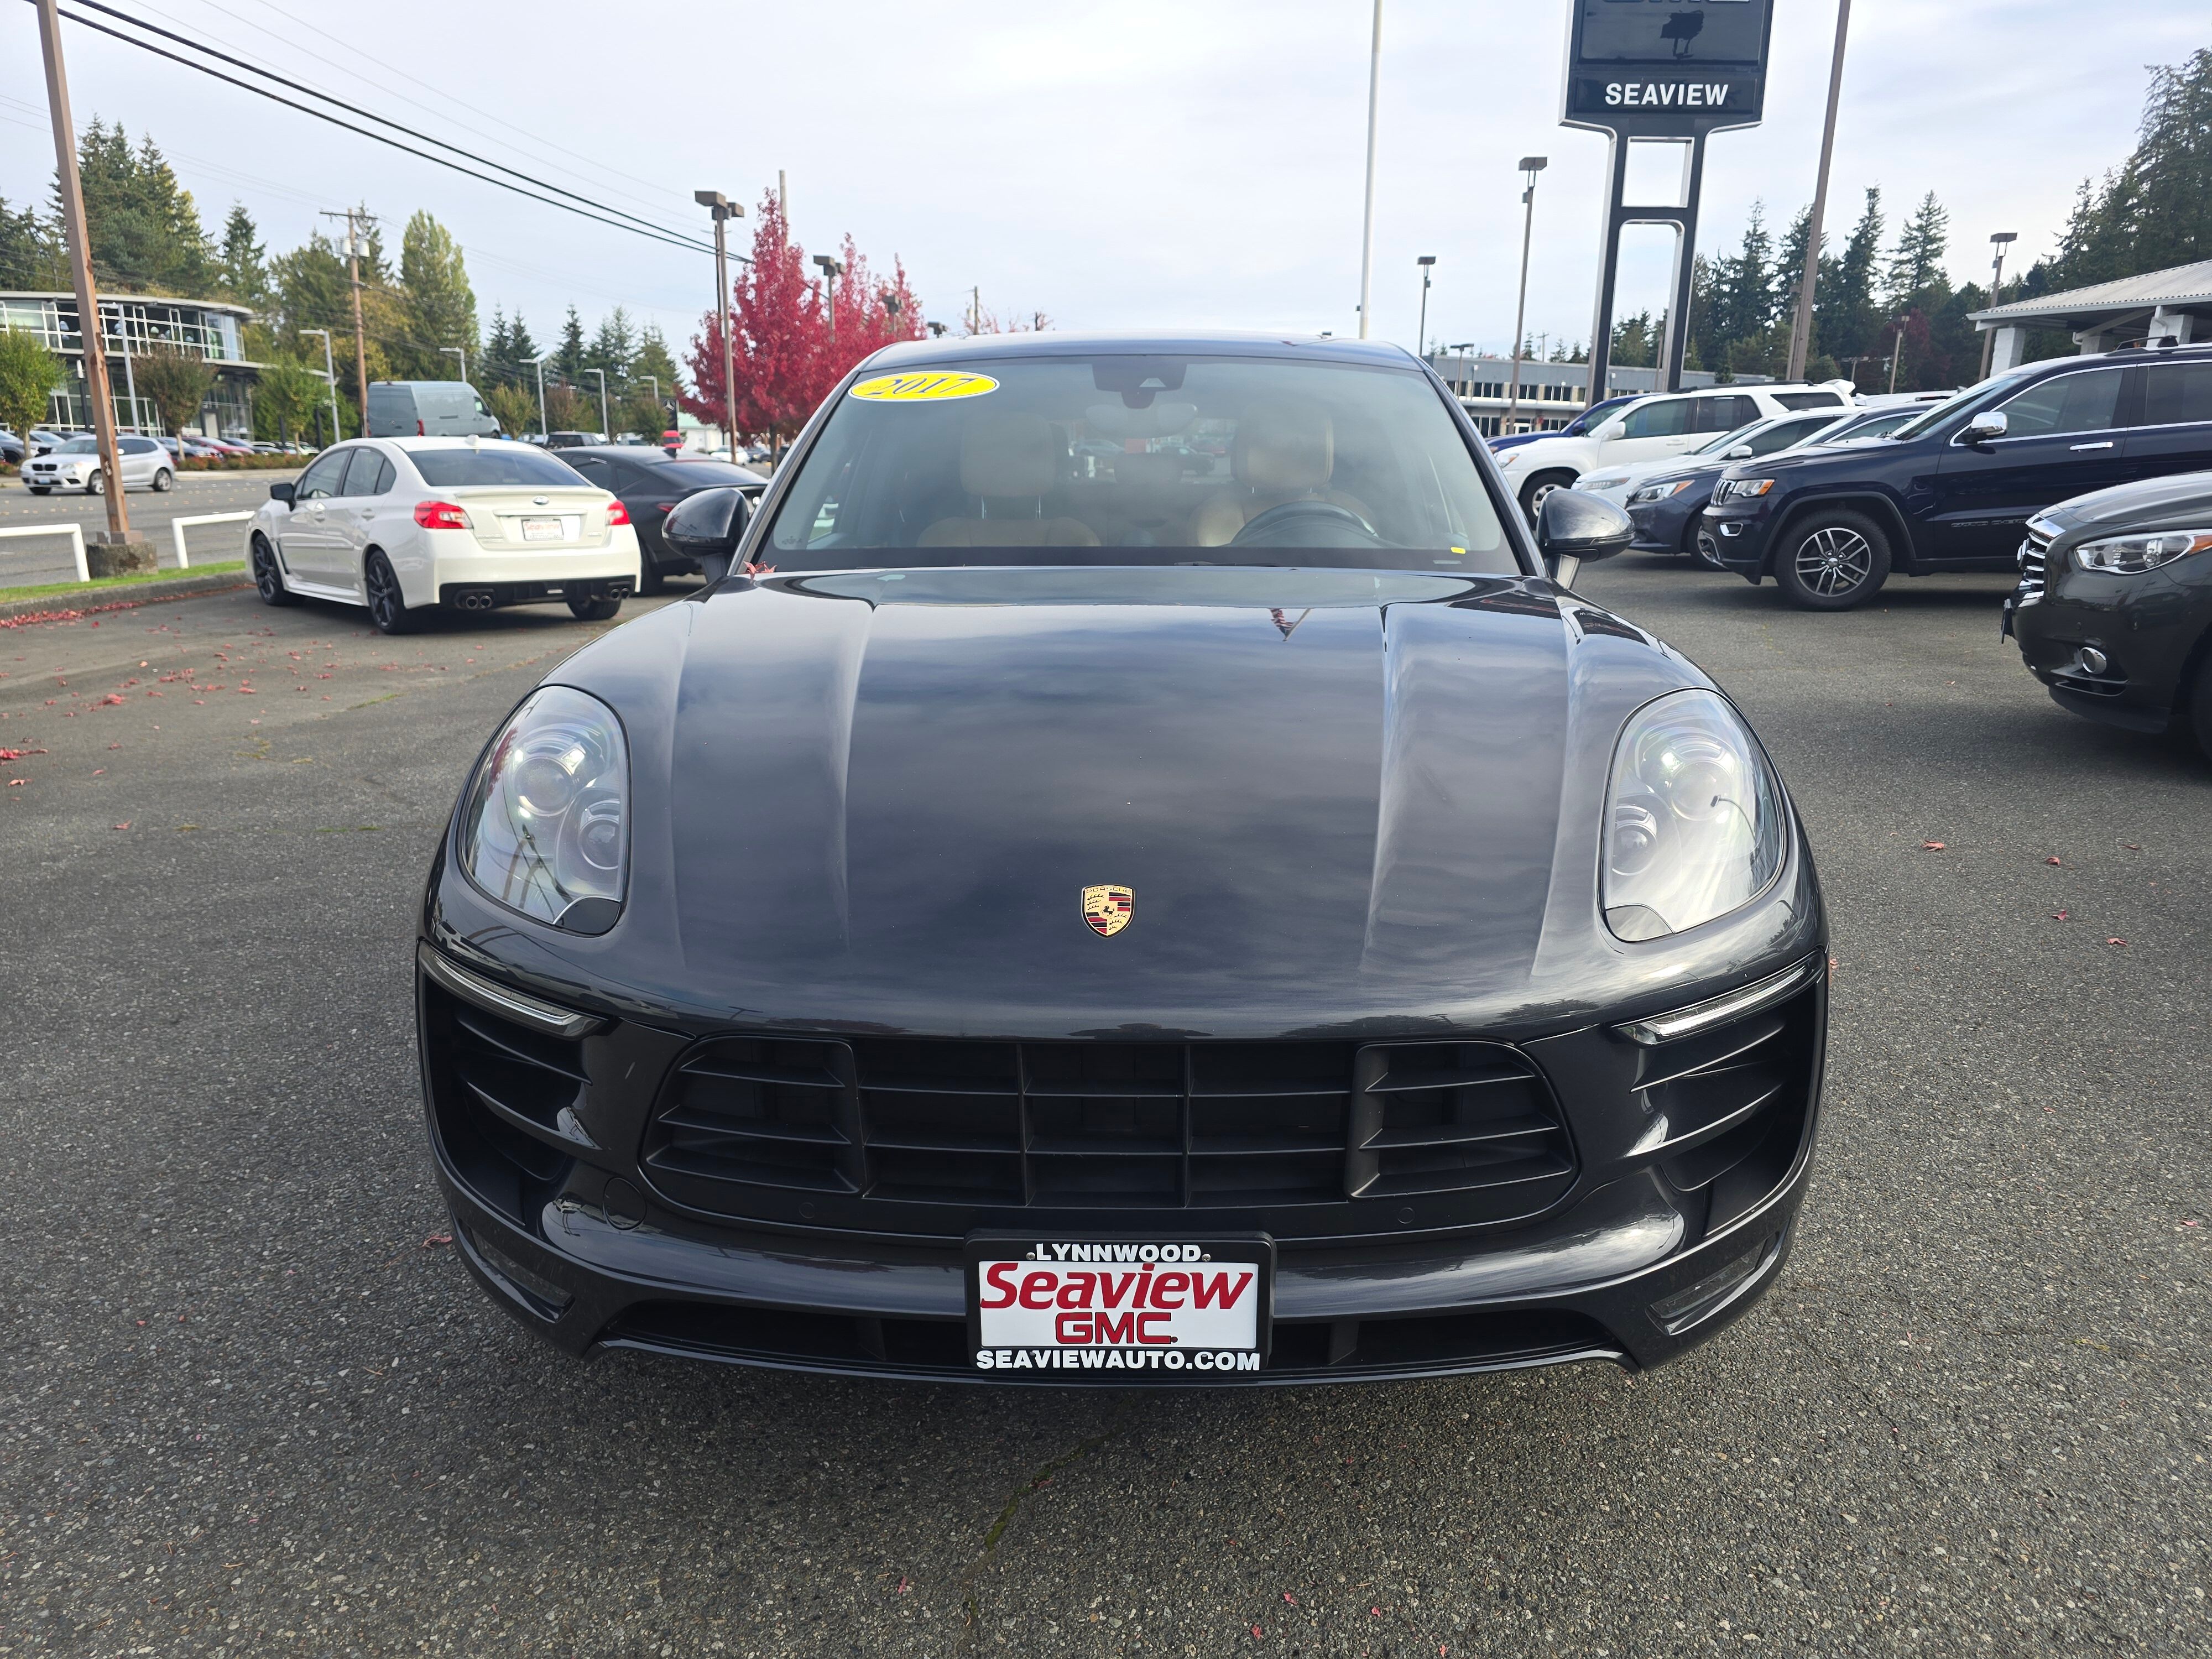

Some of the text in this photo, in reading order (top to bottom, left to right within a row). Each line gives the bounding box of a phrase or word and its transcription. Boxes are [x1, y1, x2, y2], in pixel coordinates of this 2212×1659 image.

[1605, 82, 1729, 106] SEAVIEW
[864, 377, 979, 395] 2017
[1036, 1243, 1201, 1262] LYNNWOOD
[980, 1262, 1254, 1310] Seaview
[1055, 1312, 1172, 1344] GMC
[976, 1349, 1260, 1371] SEAVIEWAUTO.COM
